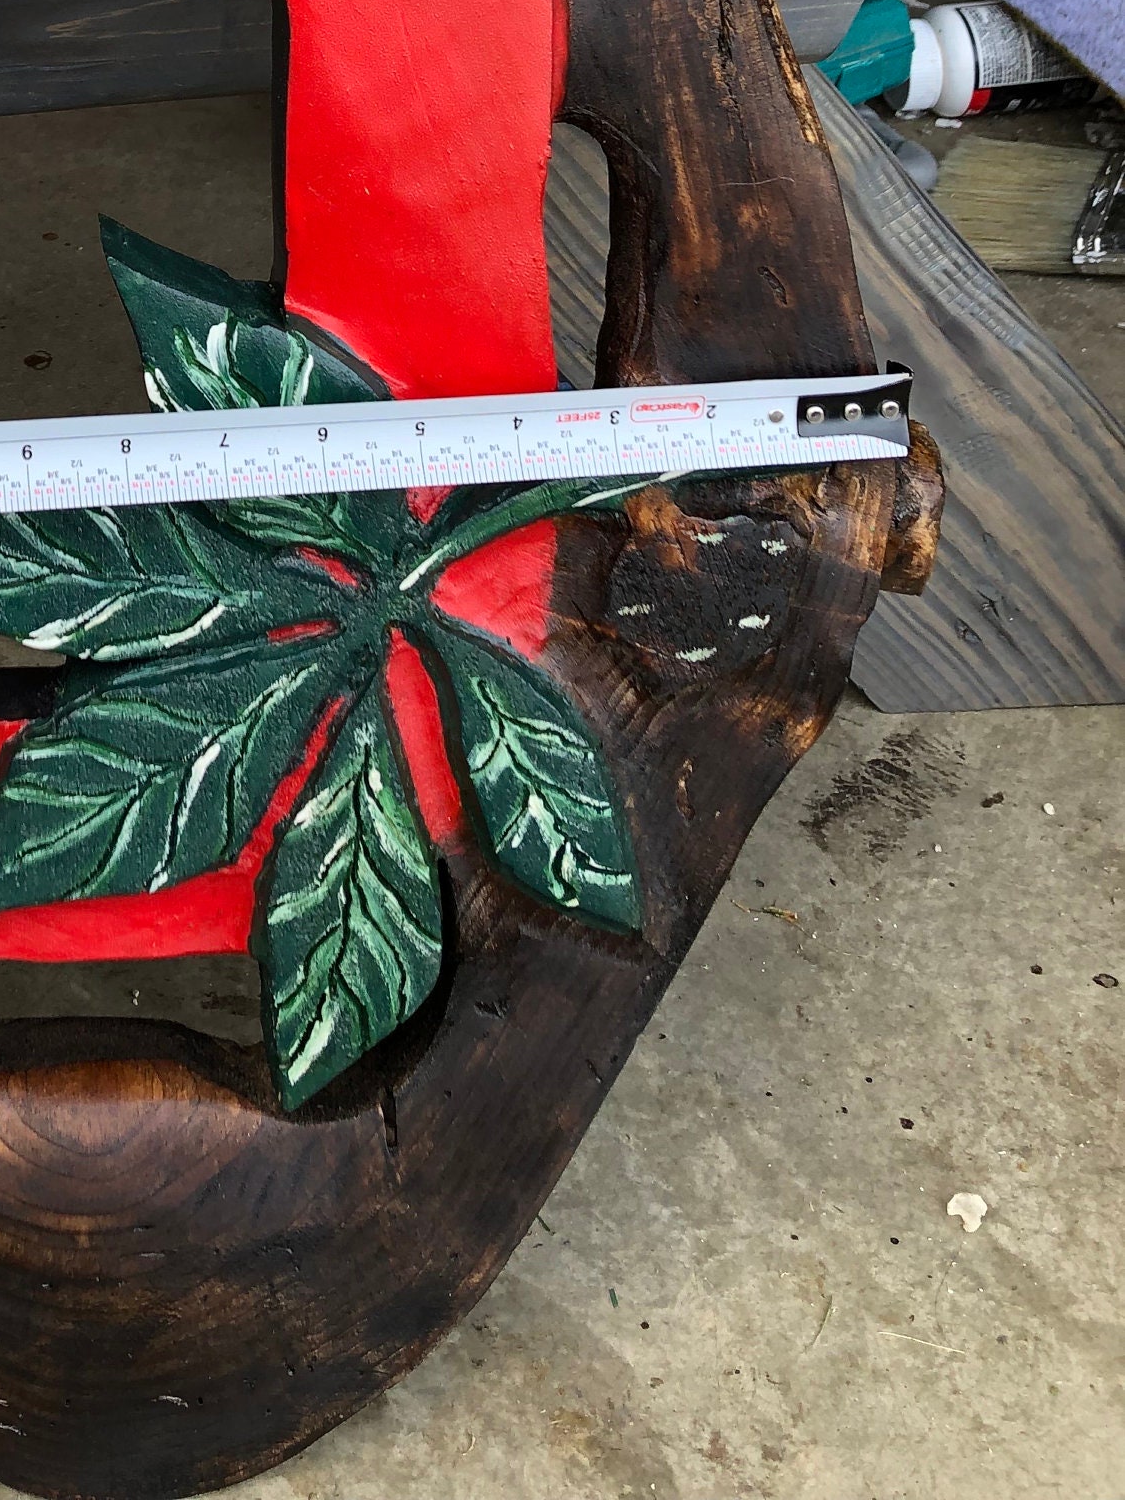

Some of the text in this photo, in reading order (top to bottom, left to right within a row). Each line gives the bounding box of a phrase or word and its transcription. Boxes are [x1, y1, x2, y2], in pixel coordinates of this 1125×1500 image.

[555, 411, 601, 423] 25FEET
[610, 411, 619, 424] 3
[707, 405, 716, 419] 2
[416, 422, 425, 436] 5
[514, 417, 523, 430] 4
[220, 433, 229, 447] 7
[318, 427, 327, 442] 6
[22, 445, 32, 460] 9
[121, 439, 131, 453] 8
